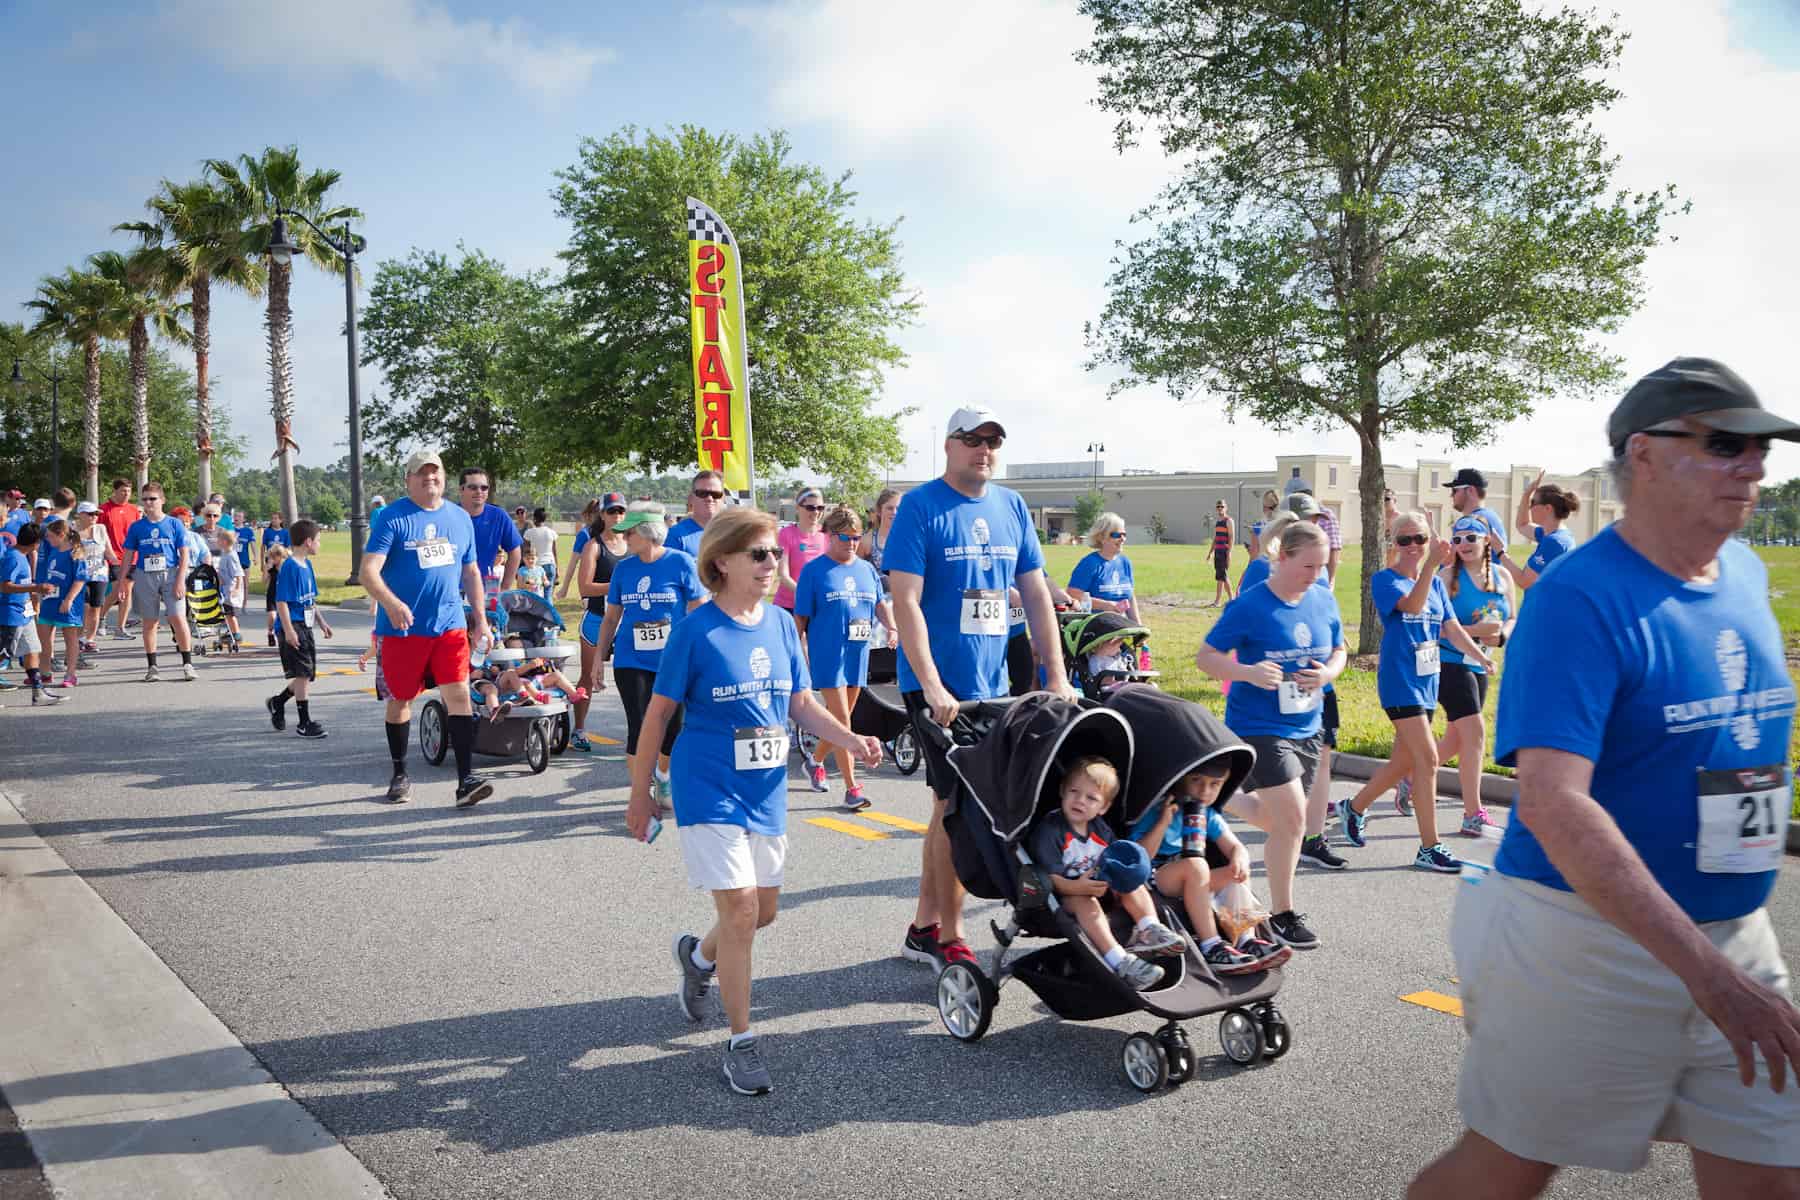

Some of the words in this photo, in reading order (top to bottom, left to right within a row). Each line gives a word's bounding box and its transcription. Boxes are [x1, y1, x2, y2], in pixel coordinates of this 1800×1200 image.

[972, 601, 1000, 619] 138
[640, 628, 665, 641] 351
[712, 685, 737, 698] RUN
[738, 681, 762, 694] WITH
[748, 739, 782, 763] 137
[1738, 796, 1776, 837] 21
